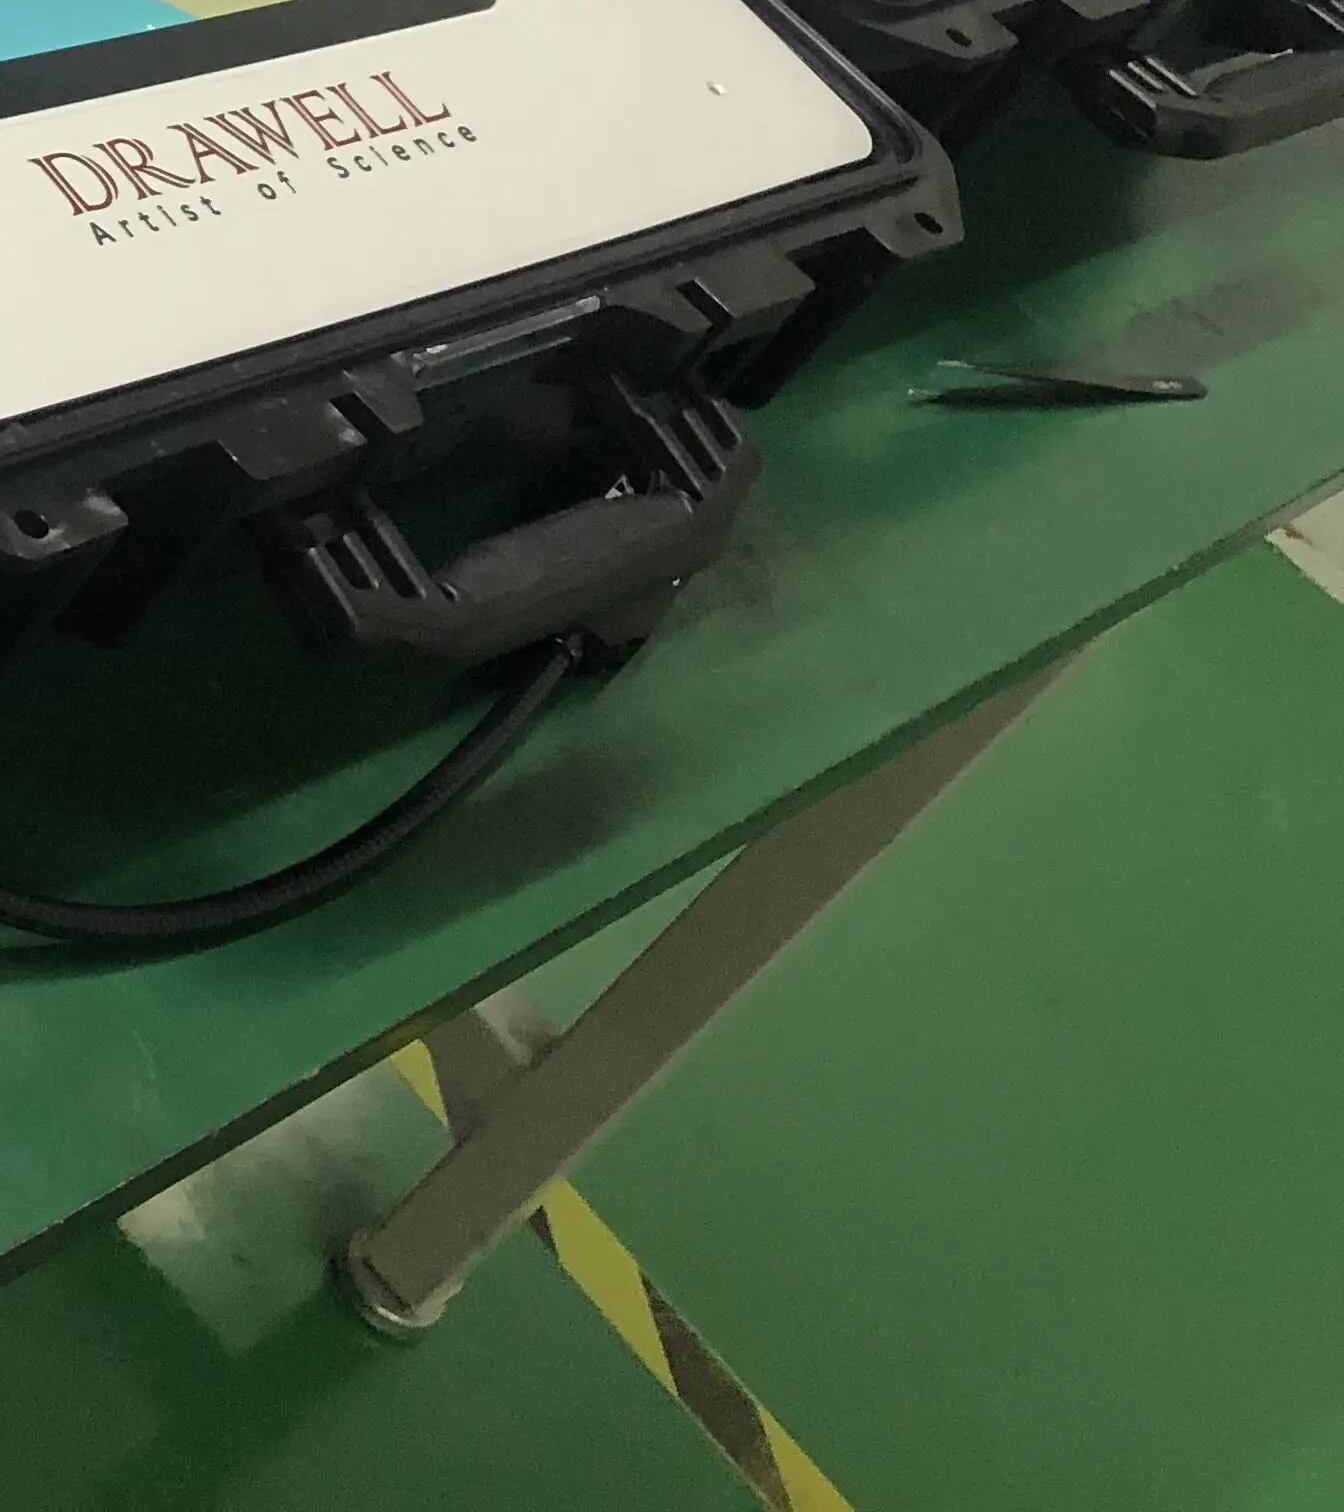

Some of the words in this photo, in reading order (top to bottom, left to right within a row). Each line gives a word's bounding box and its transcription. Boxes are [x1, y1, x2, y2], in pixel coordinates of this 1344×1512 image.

[27, 70, 452, 217] DRAWELL
[89, 194, 222, 248] Artist
[256, 170, 297, 202] of
[326, 121, 478, 180] Science
